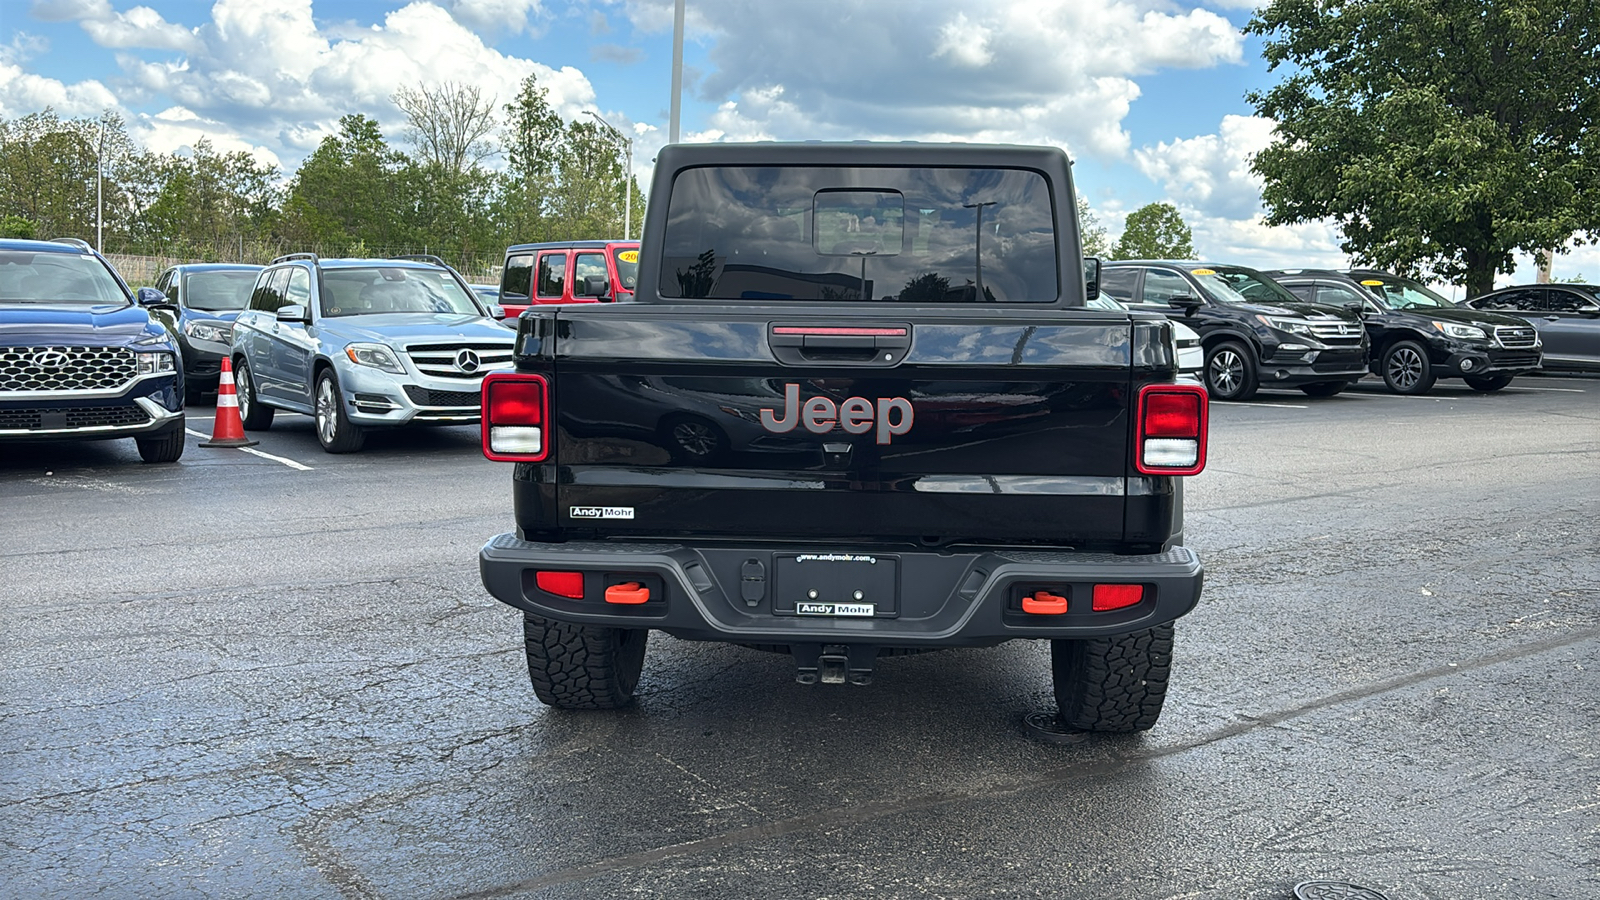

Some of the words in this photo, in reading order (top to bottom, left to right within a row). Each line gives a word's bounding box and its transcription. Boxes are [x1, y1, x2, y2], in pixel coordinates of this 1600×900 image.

[760, 383, 914, 445] Jeep
[573, 508, 602, 517] Andy
[800, 553, 871, 561] www.andymohr.com
[801, 604, 833, 614] Andy
[838, 606, 871, 614] Mohr
